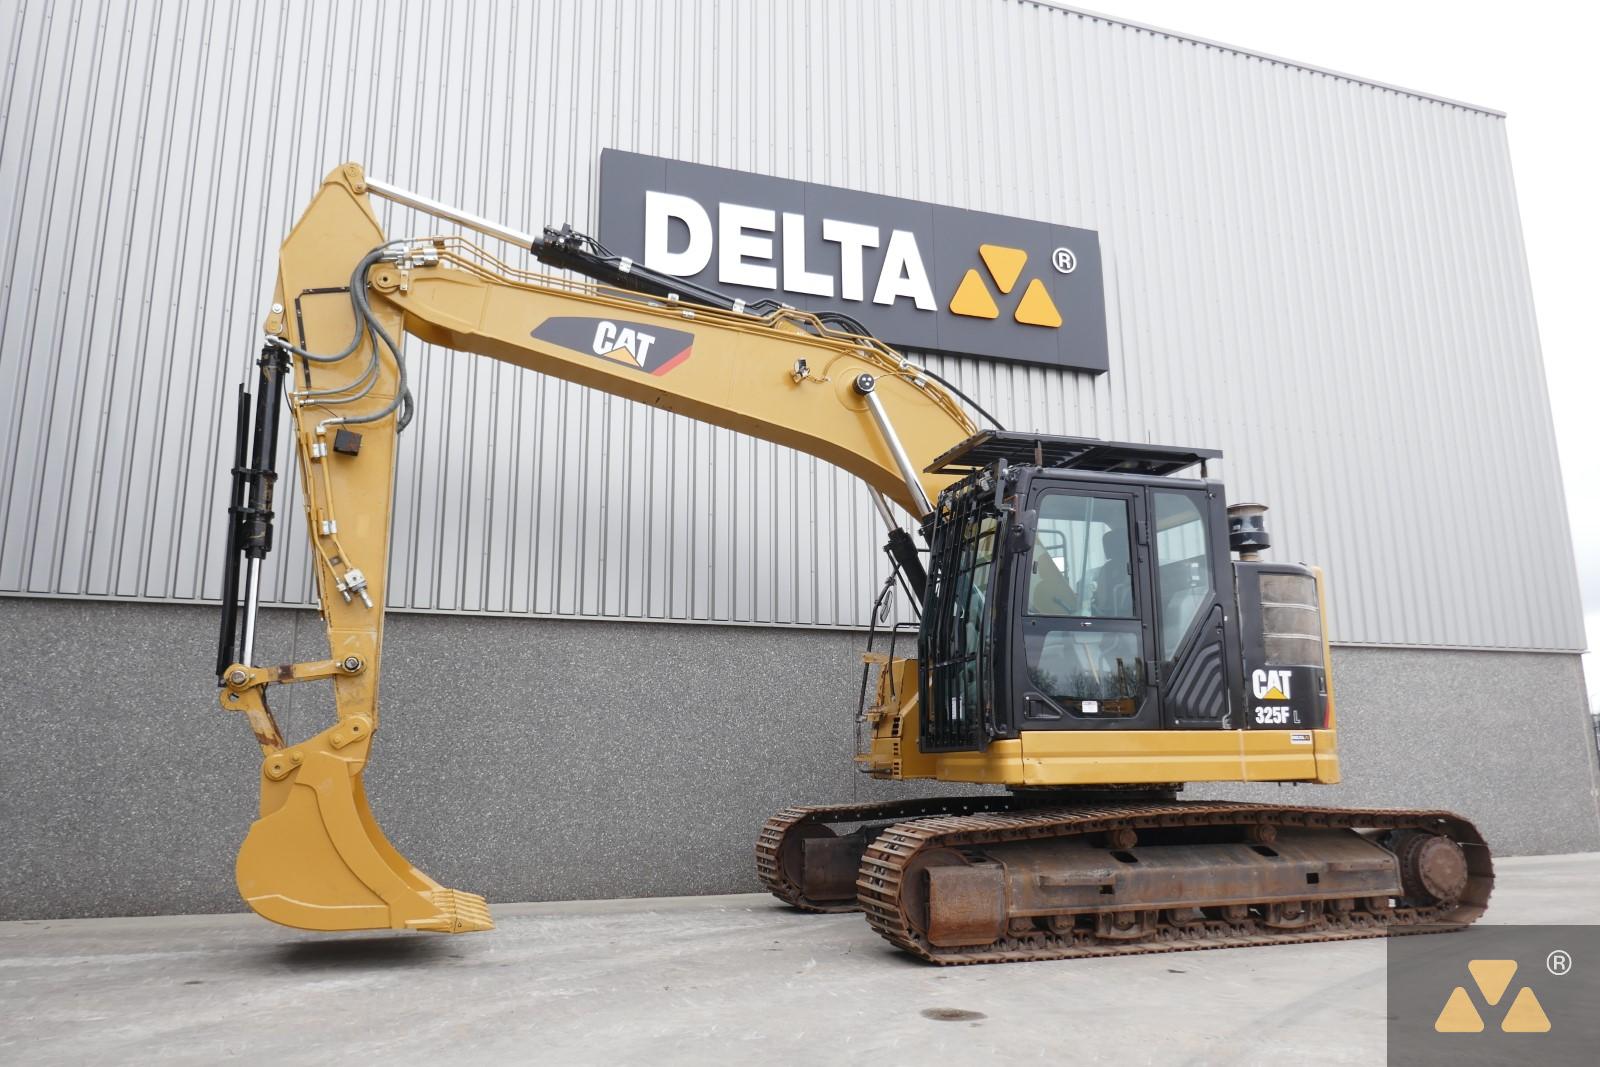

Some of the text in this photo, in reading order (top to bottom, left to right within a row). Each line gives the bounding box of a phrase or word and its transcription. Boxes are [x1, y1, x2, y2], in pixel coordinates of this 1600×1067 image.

[644, 190, 938, 312] DELTA
[592, 320, 656, 368] CAT
[1252, 669, 1292, 699] CAT
[1255, 706, 1301, 723] 325F L
